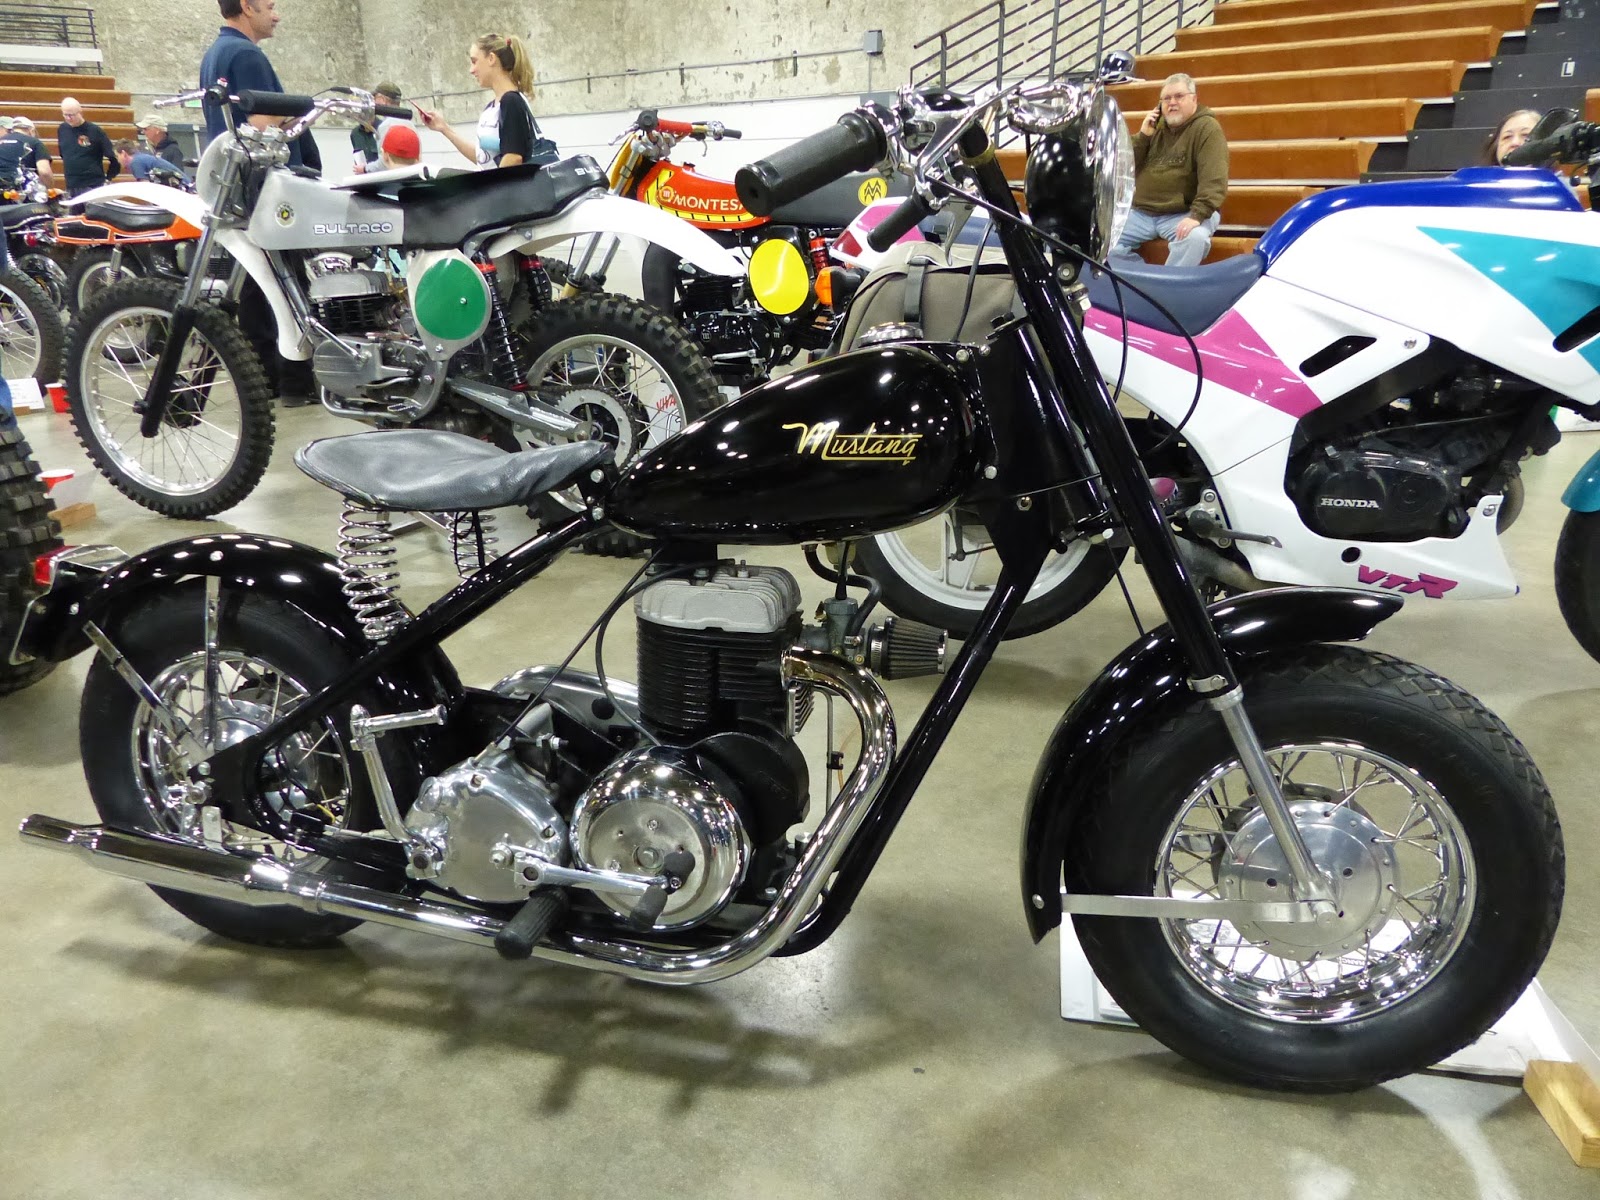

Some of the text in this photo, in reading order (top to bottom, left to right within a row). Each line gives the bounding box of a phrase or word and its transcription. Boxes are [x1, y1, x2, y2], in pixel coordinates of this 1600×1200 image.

[313, 222, 393, 235] BULTACO
[782, 421, 924, 466] Mustang
[1320, 497, 1380, 508] HONDA
[1357, 564, 1459, 600] VTR
